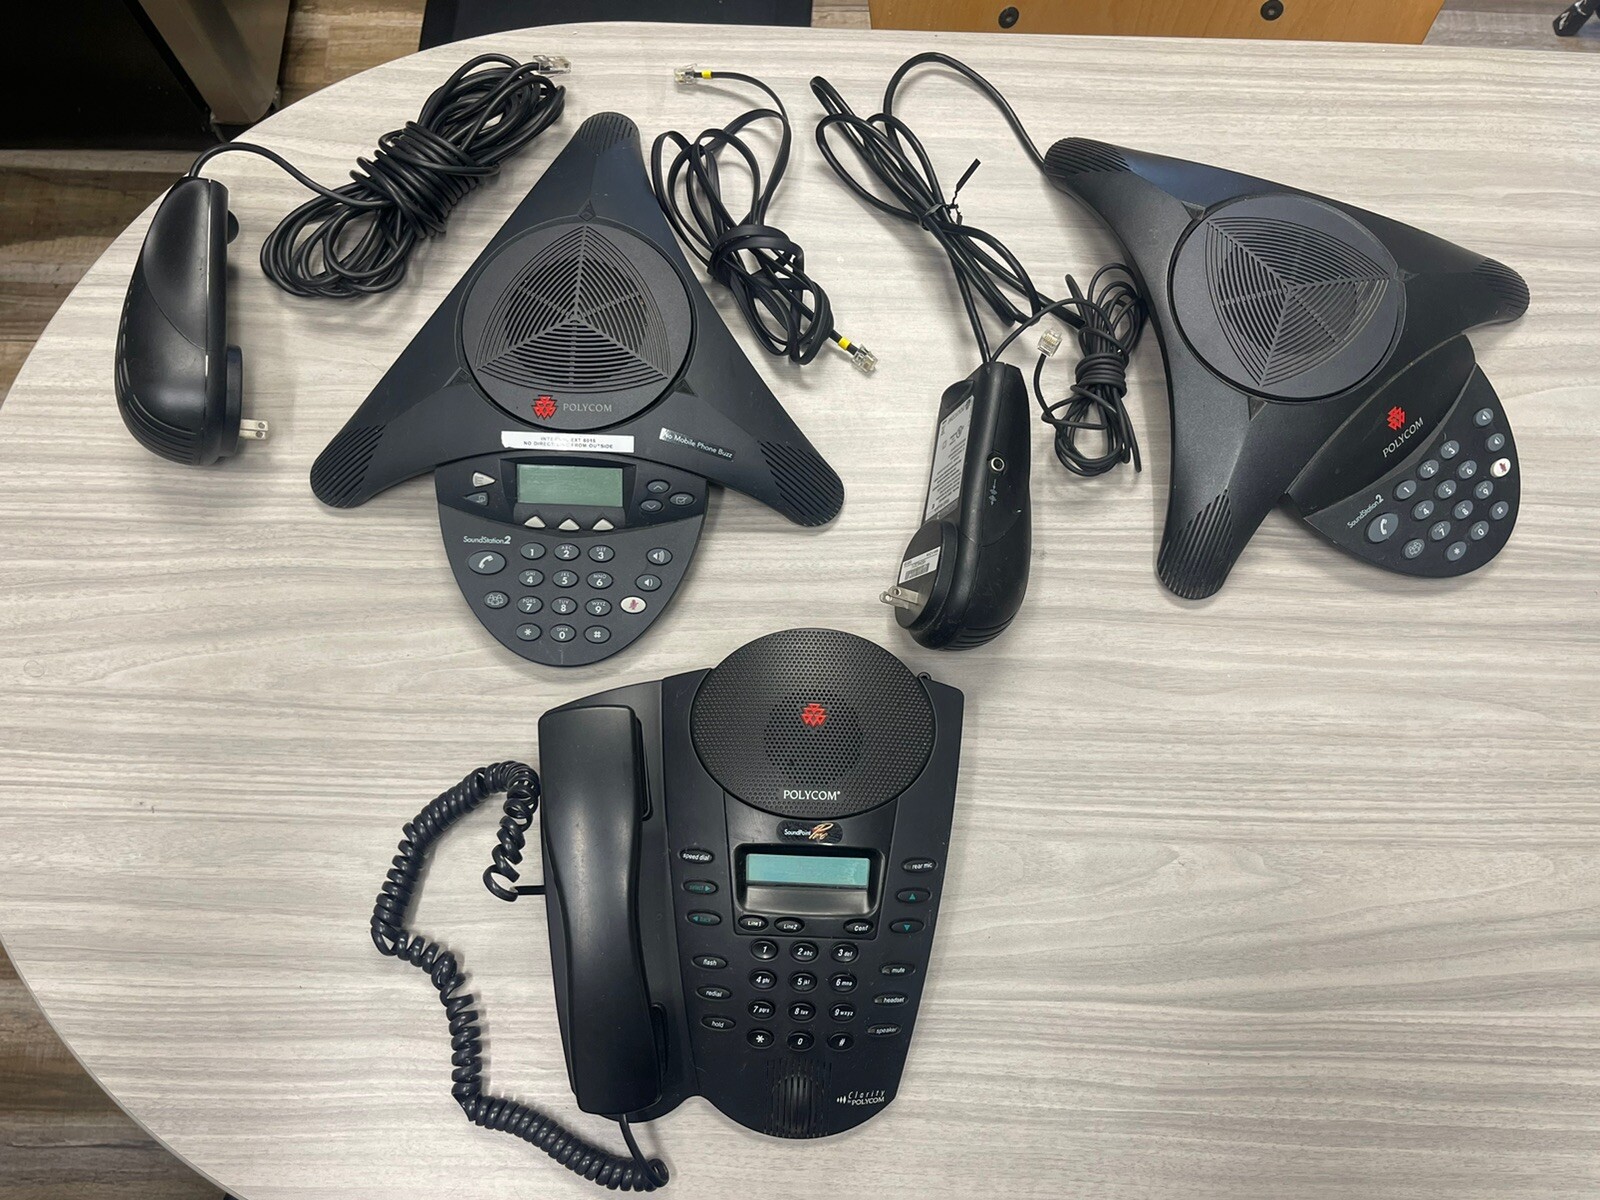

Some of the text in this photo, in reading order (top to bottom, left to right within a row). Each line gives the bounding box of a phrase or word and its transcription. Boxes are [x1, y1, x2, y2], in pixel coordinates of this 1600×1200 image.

[563, 403, 612, 412] POLYCOM
[1382, 417, 1424, 458] POLYCOM
[673, 434, 696, 447] Mobile
[696, 441, 717, 453] Phone
[717, 448, 733, 459] Buzz
[1448, 447, 1456, 455] 3
[1426, 466, 1435, 474] 2
[1403, 486, 1410, 494] 1
[1445, 487, 1452, 495] 5
[1482, 488, 1489, 496] 9
[1422, 507, 1430, 515] 4
[1461, 508, 1469, 516] 8
[1439, 528, 1445, 537] 7
[1477, 528, 1485, 536] 0
[529, 548, 534, 556] 1
[563, 550, 570, 558] 2
[597, 551, 604, 560] 3
[526, 576, 533, 584] 4
[561, 577, 568, 585] 5
[596, 578, 603, 587] 6
[526, 603, 532, 611] 7
[560, 604, 567, 612] 8
[595, 606, 602, 614] 9
[559, 631, 566, 640] 0
[784, 822, 834, 840] SoundPoint Pro
[682, 852, 700, 861] speed
[763, 945, 768, 954] 1
[797, 947, 804, 956] 2
[838, 949, 843, 957] 3
[702, 958, 718, 966] flash
[755, 976, 761, 984] 4
[797, 978, 803, 986] 5
[835, 978, 841, 987] 6
[753, 1005, 758, 1013] 7
[794, 1007, 800, 1015] 8
[834, 1008, 840, 1016] 9
[711, 1020, 725, 1028] hold
[797, 1037, 803, 1046] 0
[848, 1090, 886, 1100] Clarity
[851, 1096, 885, 1106] POLYCOM
